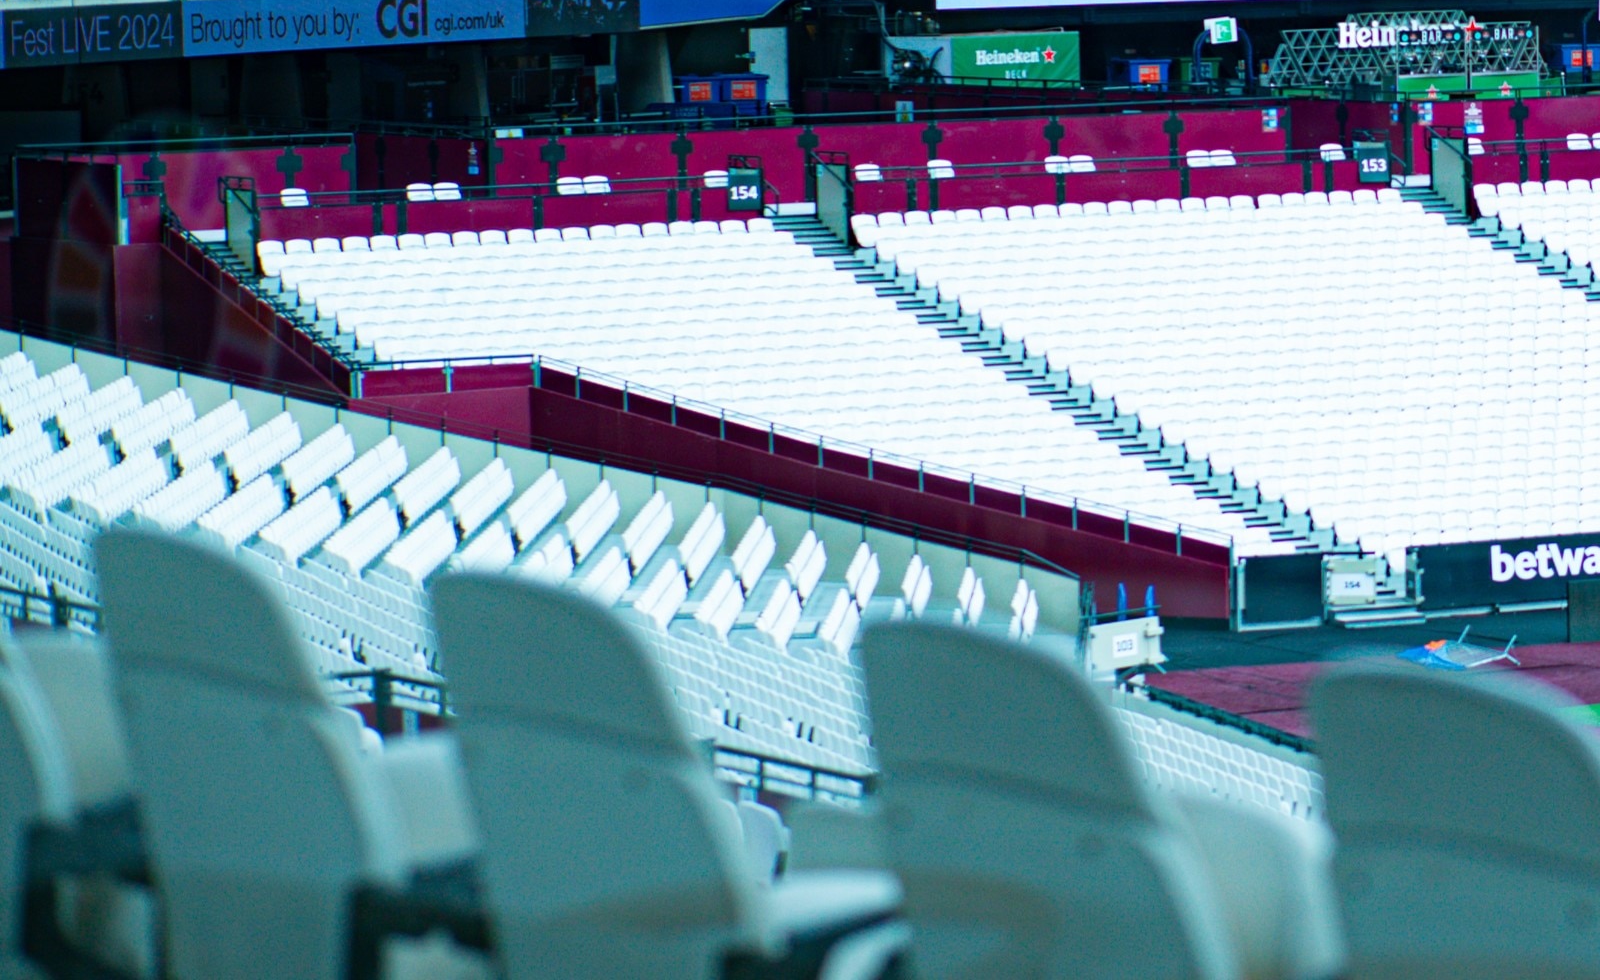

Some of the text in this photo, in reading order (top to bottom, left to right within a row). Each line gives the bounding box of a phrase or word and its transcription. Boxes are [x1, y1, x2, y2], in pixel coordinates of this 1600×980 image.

[11, 13, 175, 56] Fest LIVE 2024
[192, 10, 266, 49] Brought
[269, 12, 288, 39] to
[292, 14, 329, 46] you
[333, 7, 361, 43] by:
[434, 11, 505, 35] cgi.com/uk
[975, 48, 1040, 66] Heineken
[1361, 158, 1388, 173] 153
[730, 185, 758, 200] 154
